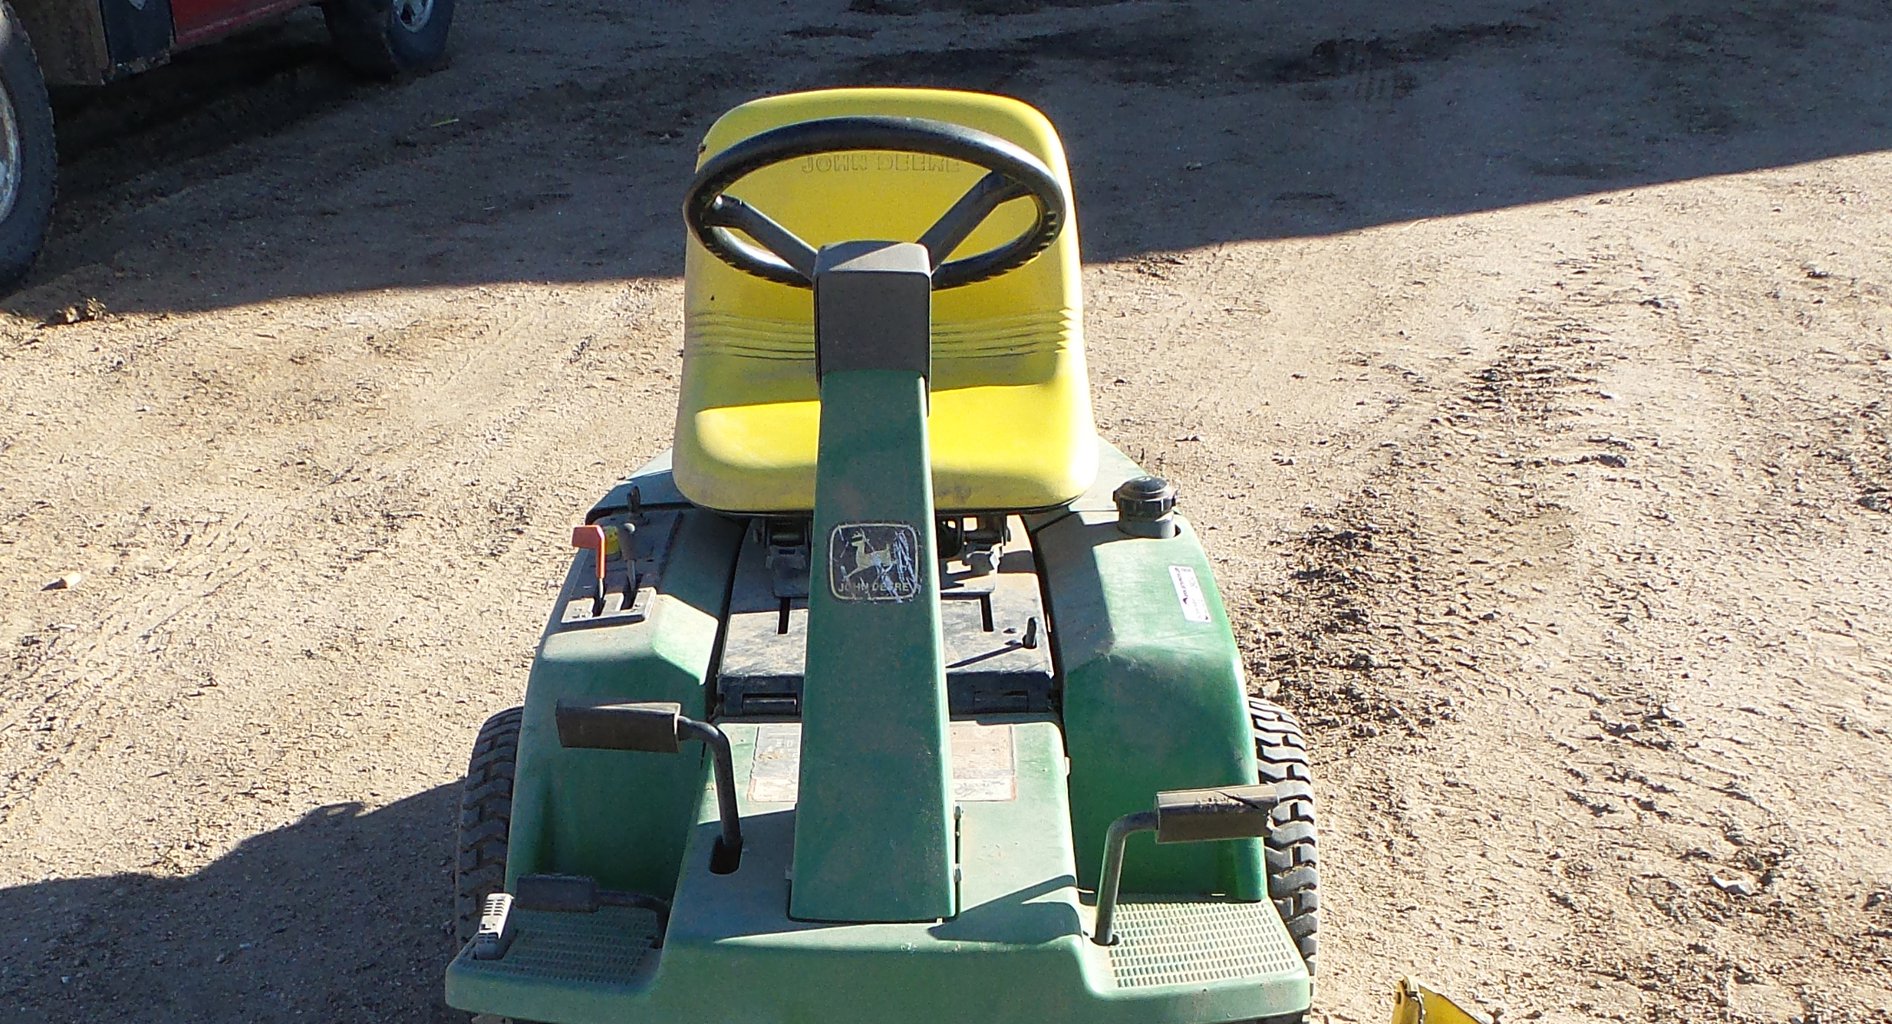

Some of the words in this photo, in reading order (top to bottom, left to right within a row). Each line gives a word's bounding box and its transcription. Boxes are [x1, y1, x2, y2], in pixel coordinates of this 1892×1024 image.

[801, 154, 868, 174] JOHN
[876, 154, 961, 173] DEERE
[872, 582, 910, 592] DERE
